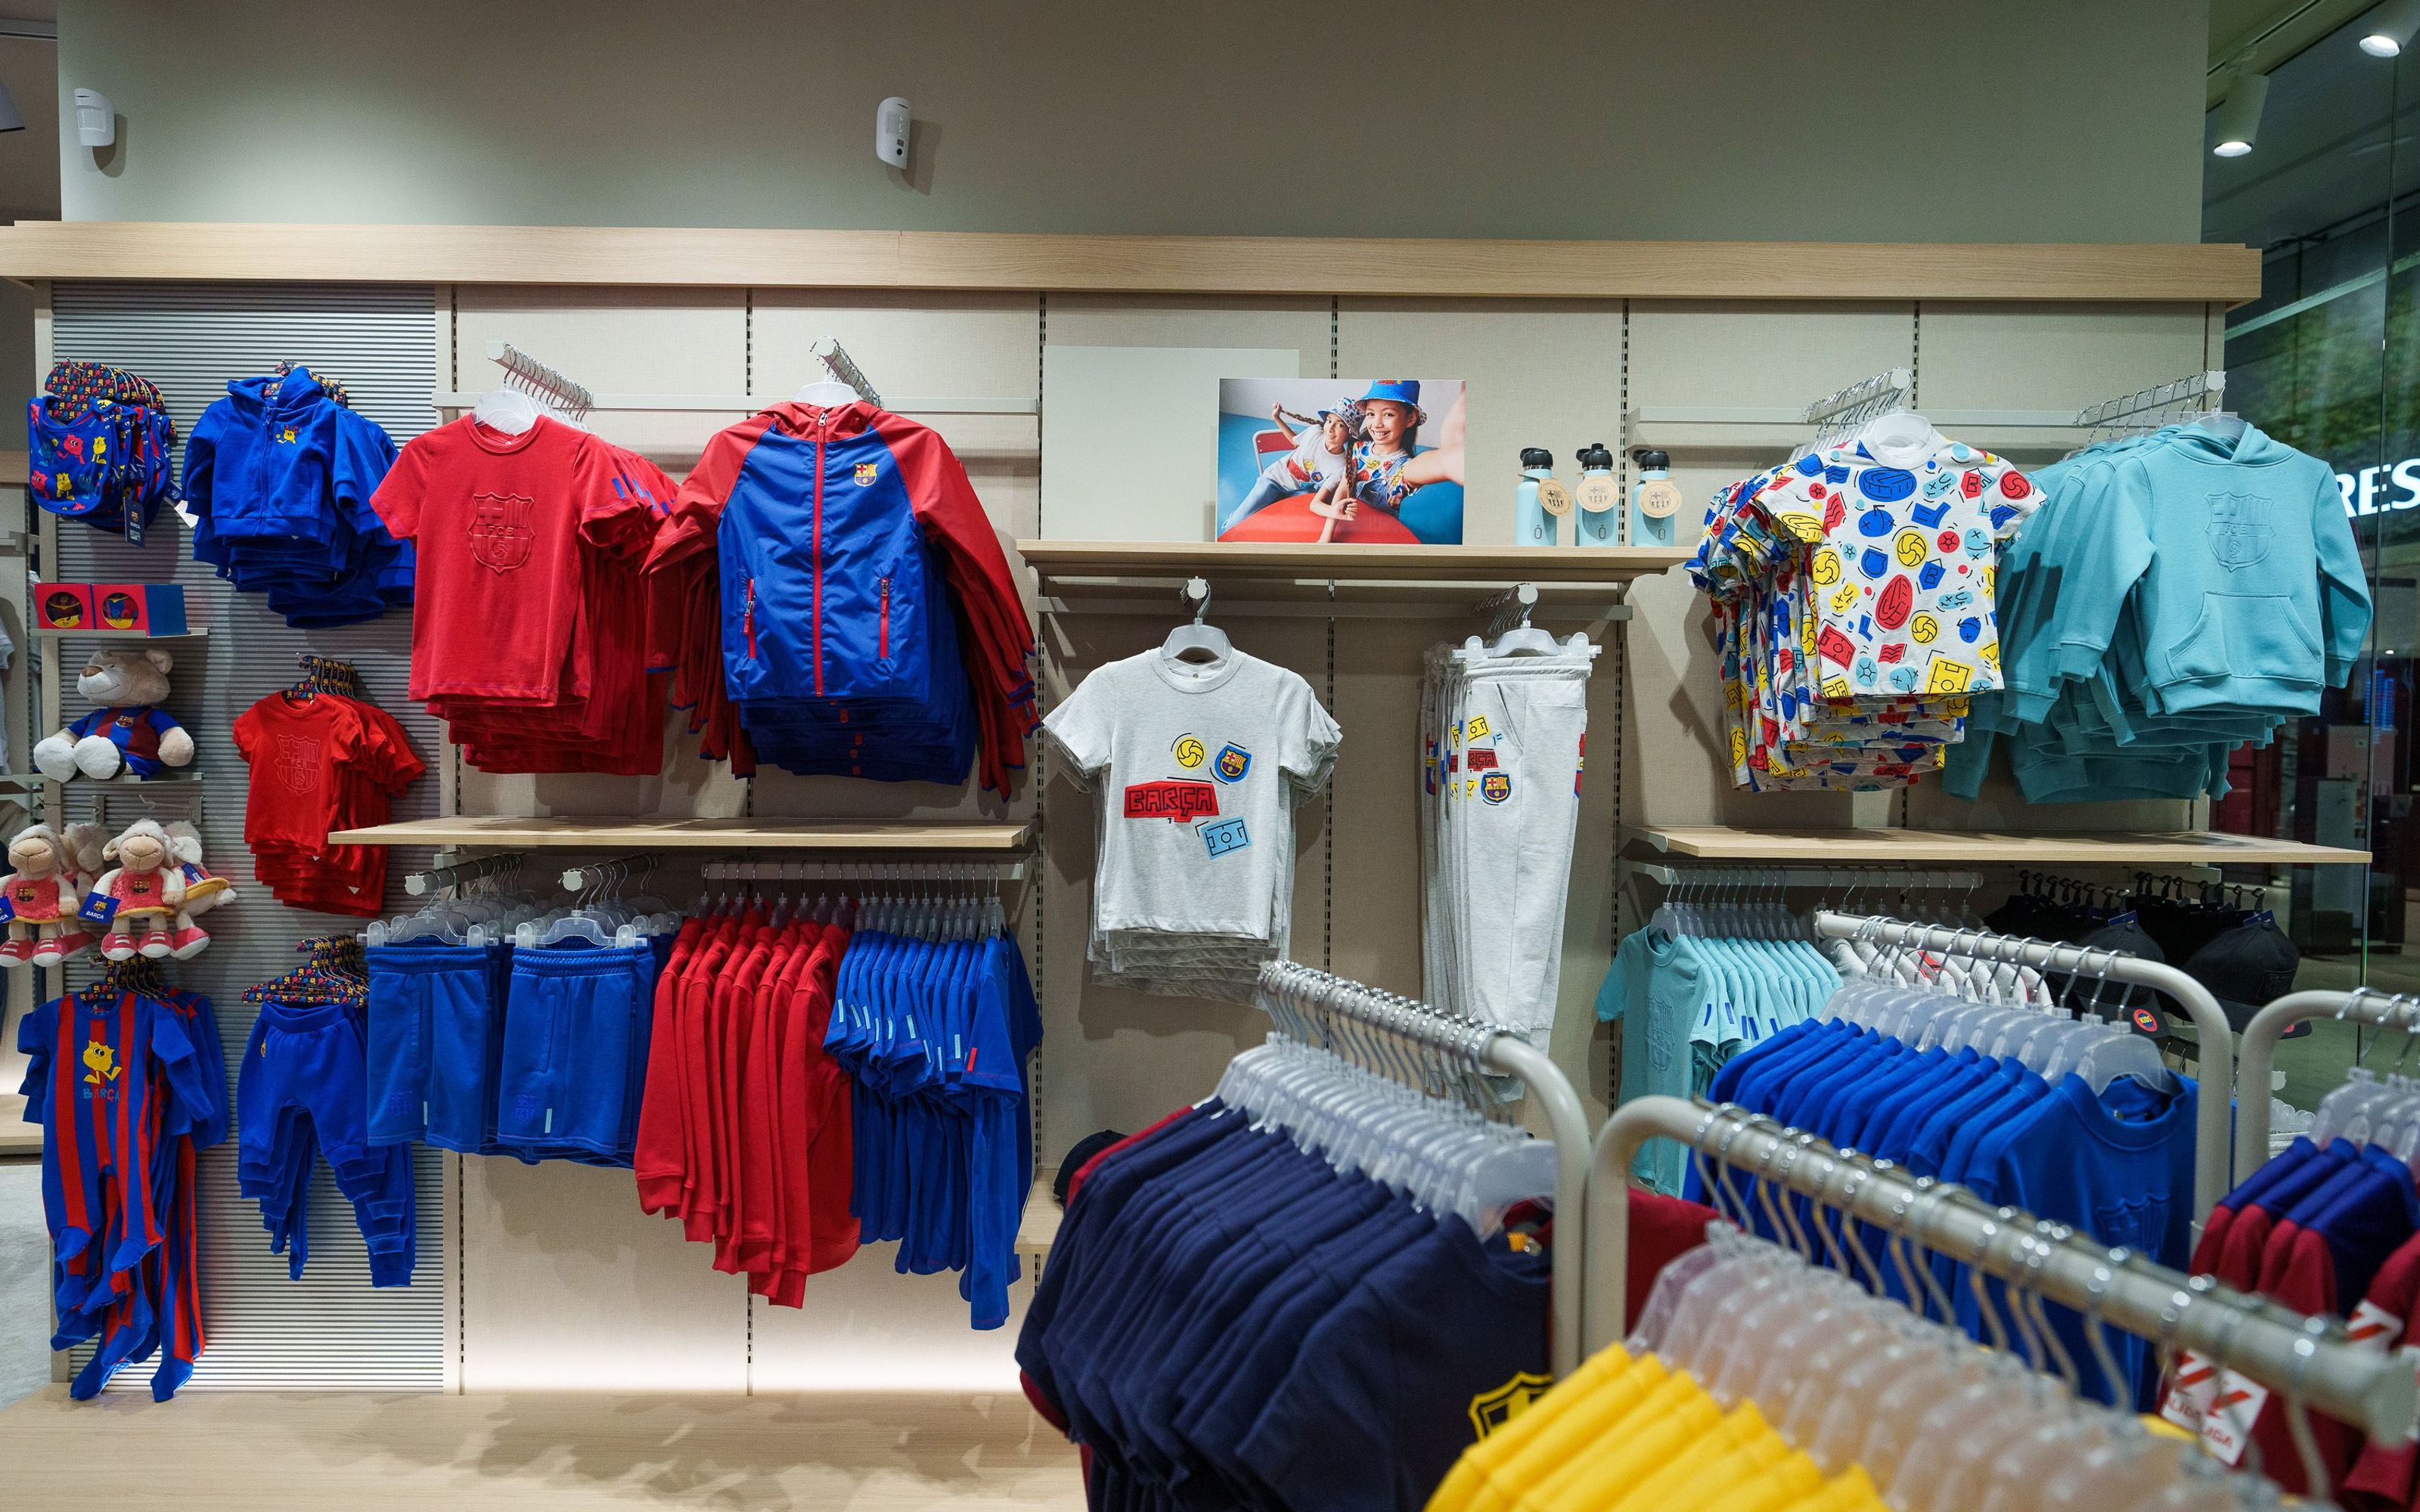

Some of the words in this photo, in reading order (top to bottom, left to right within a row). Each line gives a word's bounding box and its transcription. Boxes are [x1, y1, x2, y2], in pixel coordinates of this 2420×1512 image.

[1128, 787, 1212, 816] BARÇA
[85, 910, 104, 920] BARÇA
[2138, 1015, 2152, 1024] KIDS
[83, 1088, 119, 1101] BARÇA
